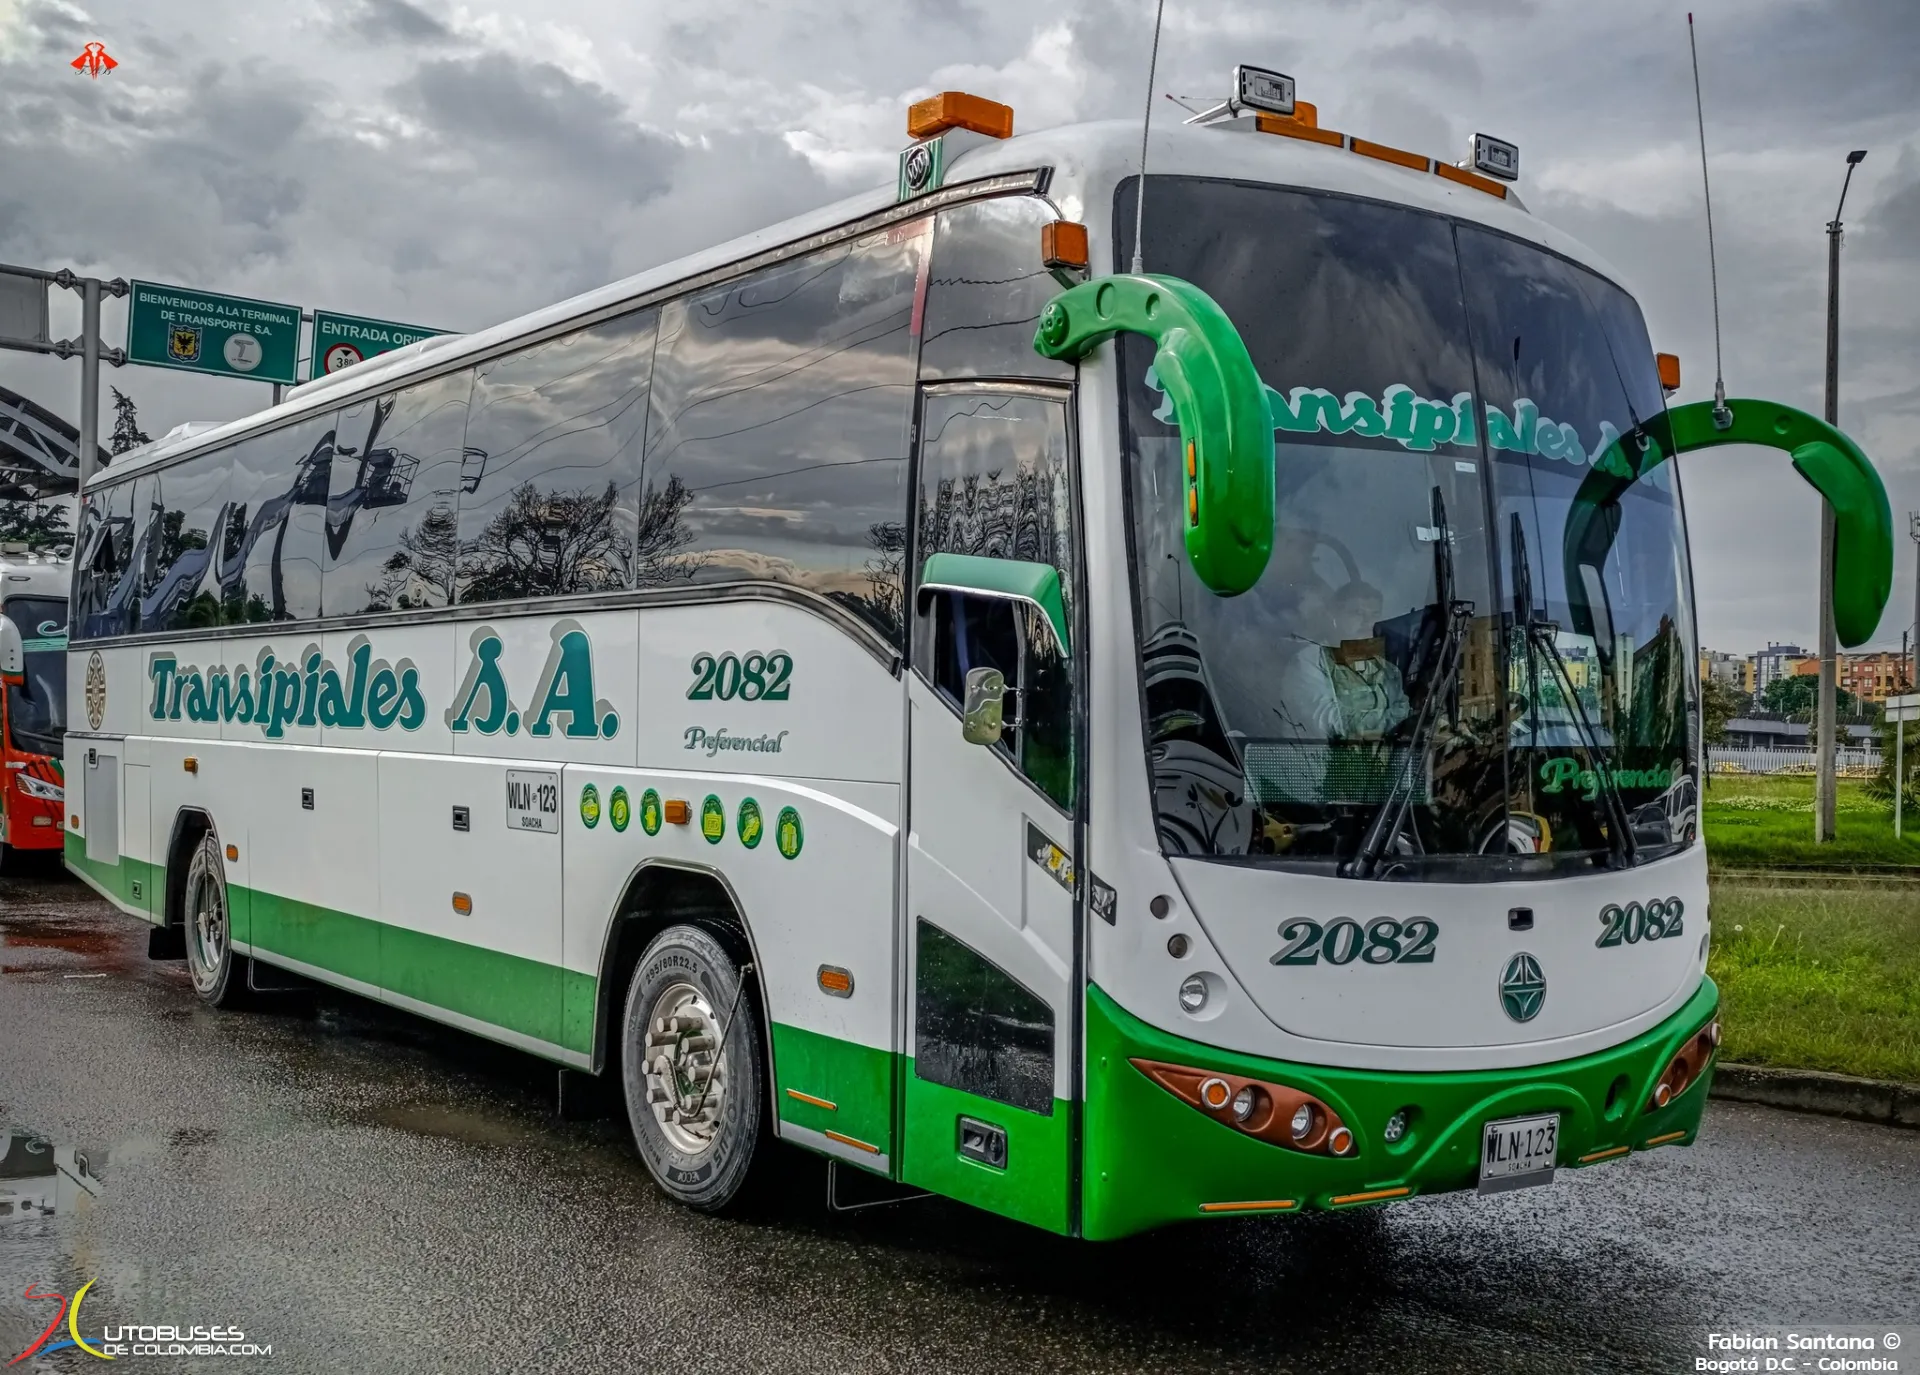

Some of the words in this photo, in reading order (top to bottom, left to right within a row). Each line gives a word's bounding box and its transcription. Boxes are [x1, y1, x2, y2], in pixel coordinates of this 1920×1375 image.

[139, 292, 214, 312] BIENVENIDOS
[216, 305, 225, 315] A
[226, 306, 239, 317] LA
[241, 308, 293, 325] TERMINAL
[161, 310, 176, 321] DE
[178, 312, 251, 332] TRANSPORTE
[254, 324, 272, 335] S.A.
[322, 321, 390, 343] ENTRADA
[1145, 366, 1587, 466] nsipiales
[148, 634, 427, 740] Transipiales
[444, 625, 521, 737] S.
[523, 618, 620, 741] A.
[686, 648, 793, 701] 2082
[684, 726, 789, 758] Preferencial
[1269, 916, 1440, 966] 2082
[1595, 896, 1685, 949] 2082
[645, 955, 698, 985] 295/80R22.5
